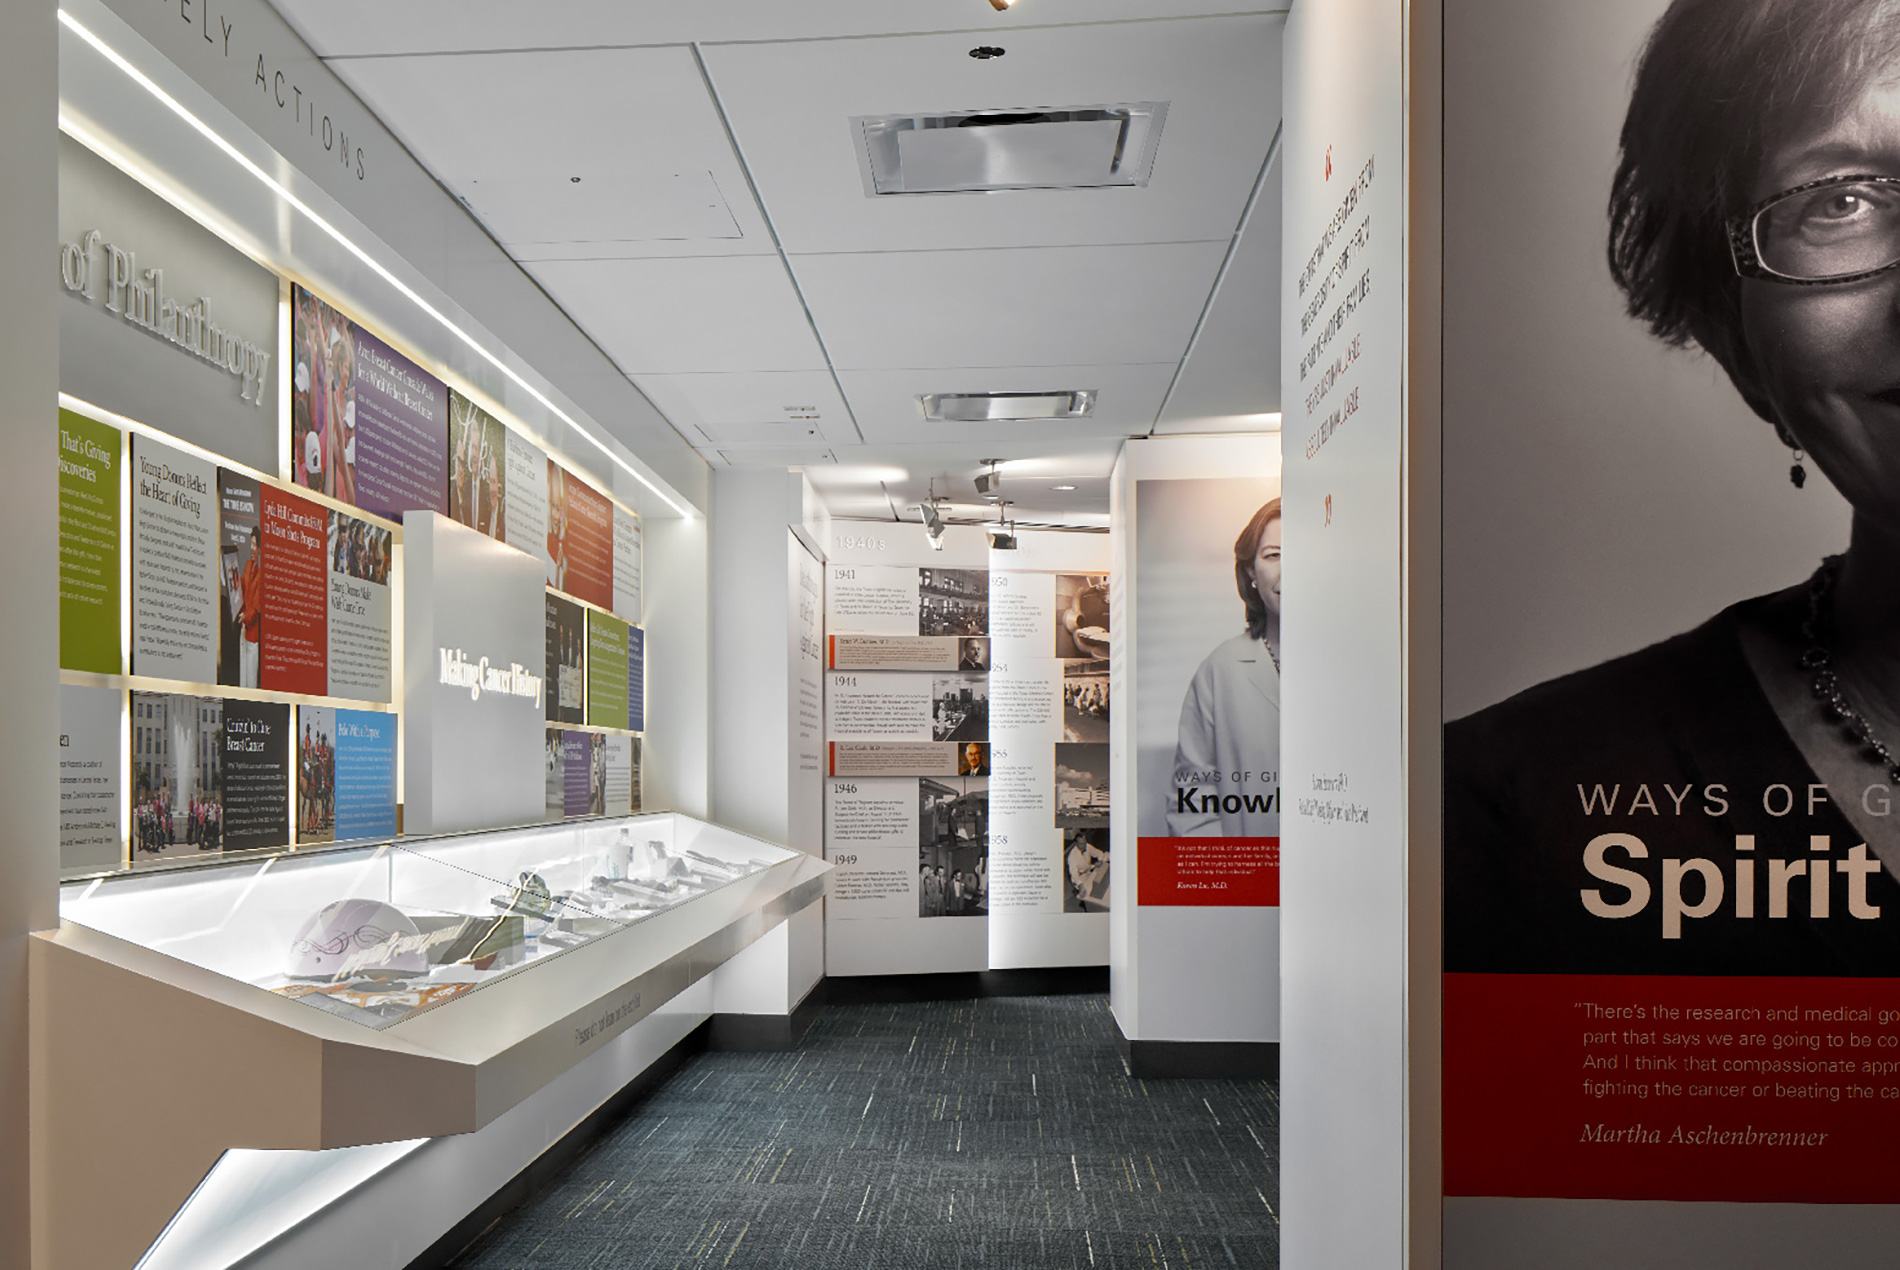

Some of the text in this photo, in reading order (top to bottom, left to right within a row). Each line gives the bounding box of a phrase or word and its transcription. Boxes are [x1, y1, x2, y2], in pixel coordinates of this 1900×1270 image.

[164, 0, 365, 181] ELY ACTIONS
[62, 229, 270, 407] of Philanthropy
[61, 430, 111, 469] That's Giving
[58, 455, 97, 483] iscoveries
[140, 456, 161, 484] Young
[162, 464, 186, 487] Donors
[140, 480, 201, 519] the Heart of Giving
[837, 535, 887, 550] 1940s
[834, 569, 856, 580] 1941
[439, 648, 481, 701] Making
[479, 656, 512, 694] Cancer
[511, 662, 542, 710] History
[226, 736, 265, 752] Breast Cancer
[1176, 771, 1222, 783] WAYS
[1231, 771, 1252, 783] OF
[834, 783, 858, 794] 1946
[1576, 783, 1729, 817] WAYS
[1762, 783, 1829, 817] OF
[834, 854, 858, 865] 1949
[1176, 881, 1198, 889] Karen
[1580, 832, 1882, 939] Spirit
[1653, 1004, 1680, 1020] the
[1686, 1005, 1761, 1021] research
[1766, 1005, 1799, 1022] and
[1804, 1006, 1873, 1022] medical
[1879, 1009, 1900, 1025] go
[1583, 1029, 1899, 1050] part that says we are going to be co
[1582, 1054, 1618, 1069] And
[1624, 1054, 1629, 1069] I
[1634, 1055, 1678, 1071] think
[1683, 1056, 1718, 1072] that
[1722, 1056, 1857, 1075] compassionate
[1583, 1079, 1649, 1099] fighting
[1654, 1081, 1683, 1097] the
[1688, 1085, 1747, 1098] cancer
[1752, 1085, 1770, 1097] or
[1775, 1082, 1841, 1101] beating
[1845, 1084, 1874, 1098] the
[1578, 1123, 1830, 1147] Martha Aschenbrenner
